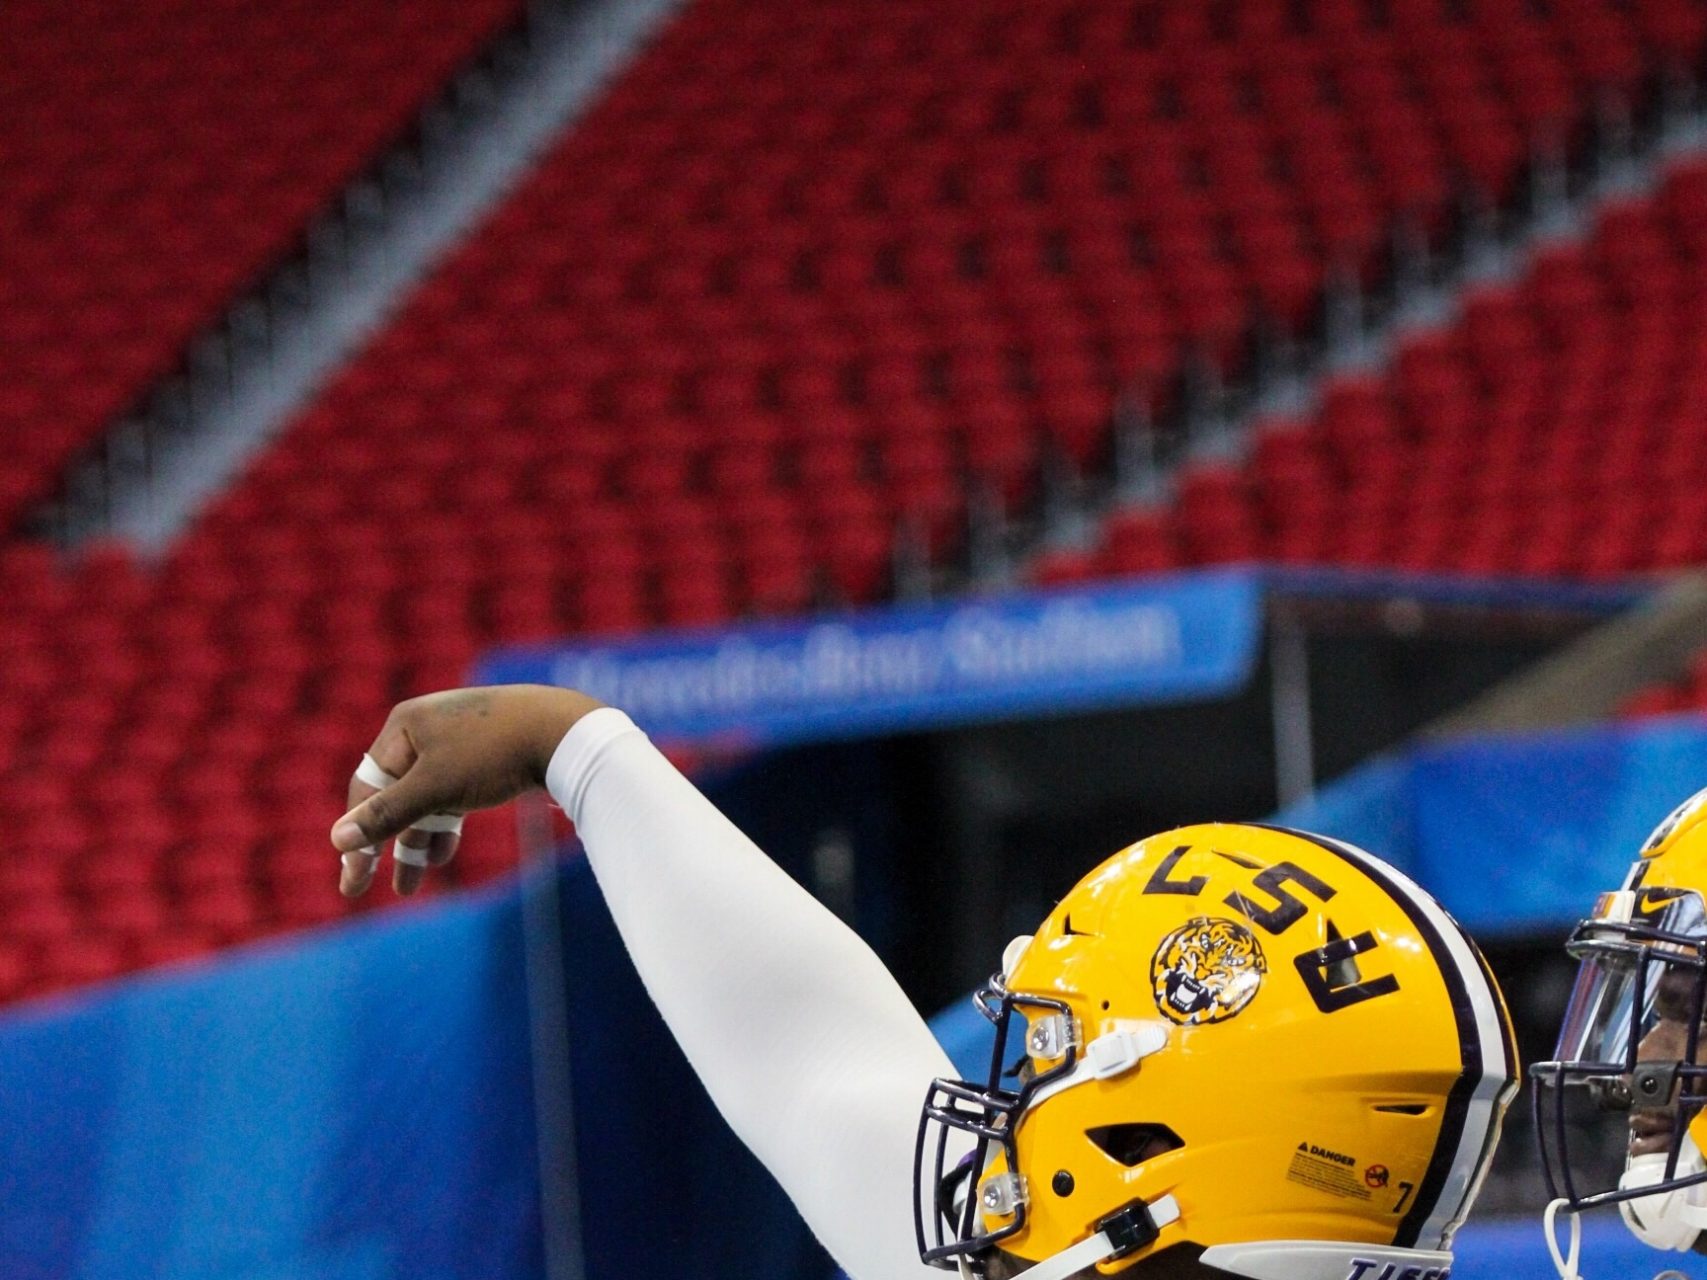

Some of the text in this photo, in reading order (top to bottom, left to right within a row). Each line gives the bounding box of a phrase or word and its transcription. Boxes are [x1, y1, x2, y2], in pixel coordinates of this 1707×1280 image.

[1142, 846, 1400, 1013] LSU
[1310, 1145, 1356, 1167] DANGER
[1391, 1181, 1414, 1213] 7
